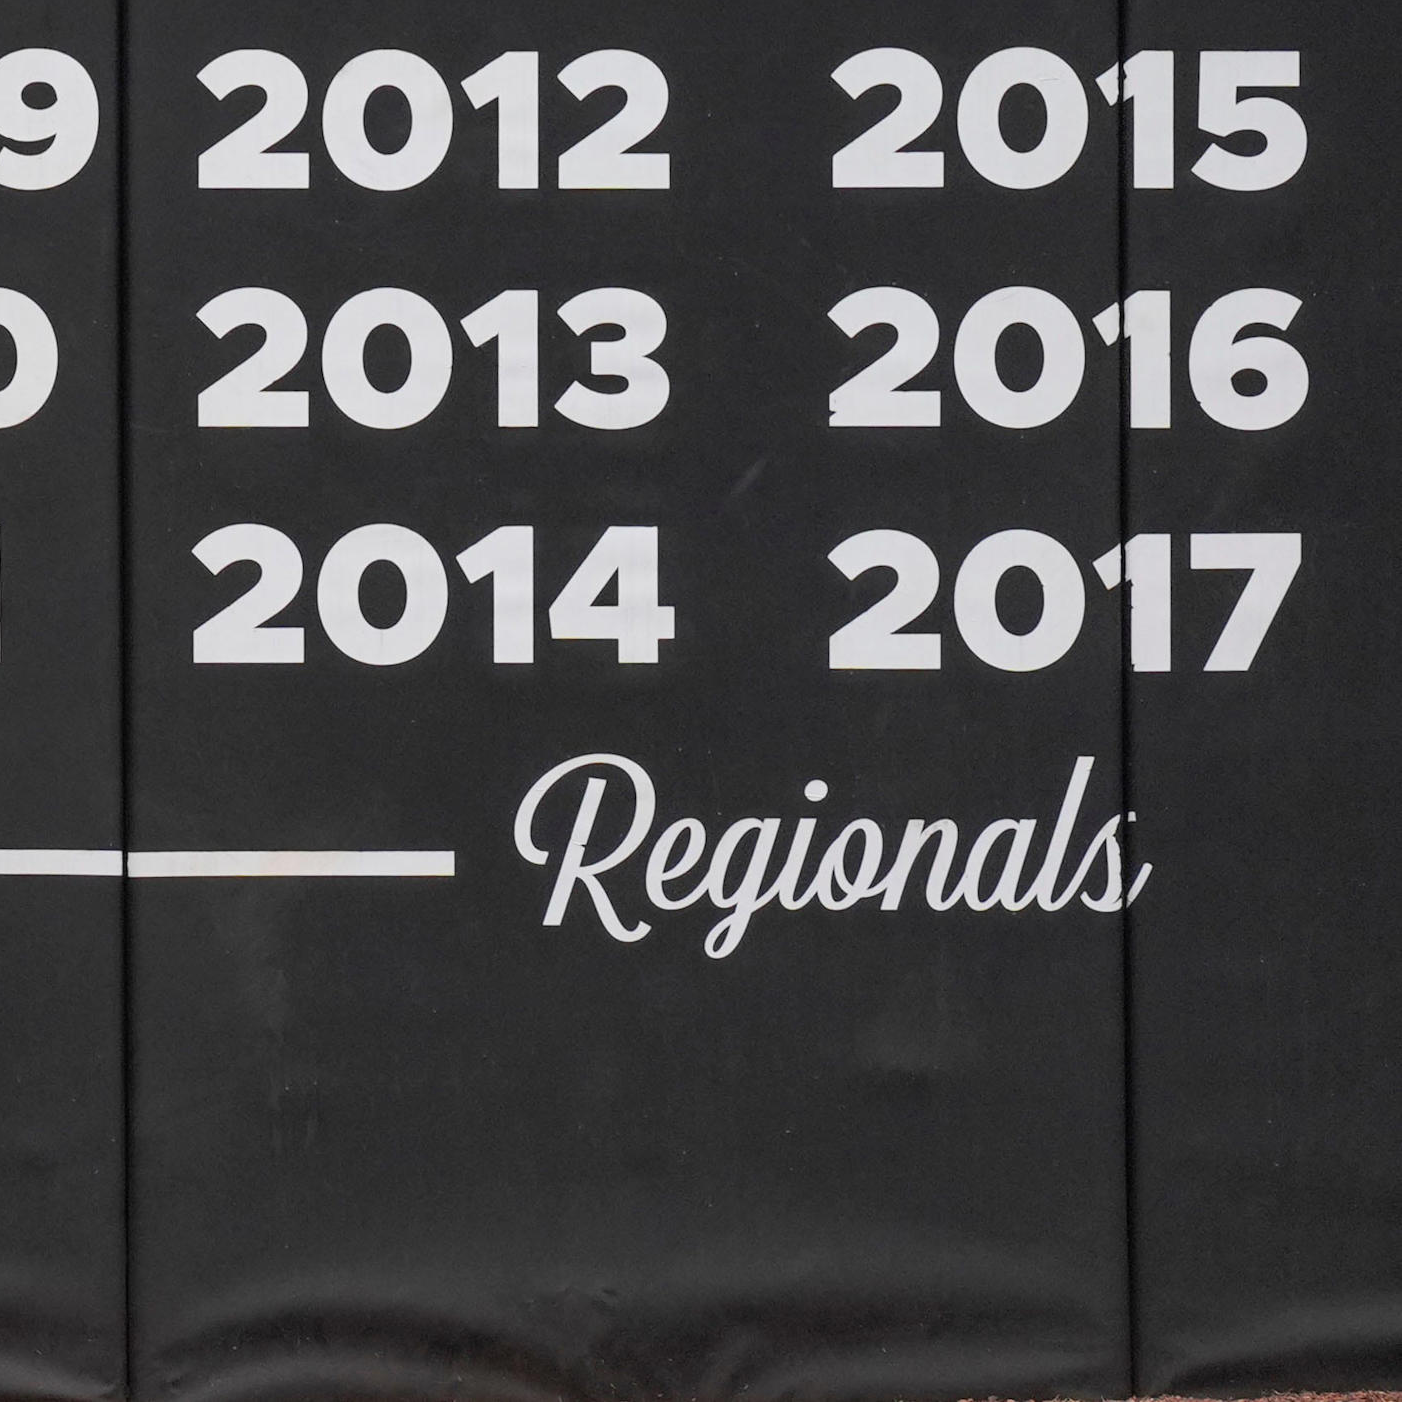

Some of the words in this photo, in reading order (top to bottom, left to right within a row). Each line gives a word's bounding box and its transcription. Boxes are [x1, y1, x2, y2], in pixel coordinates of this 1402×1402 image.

[196, 48, 671, 191] 2012
[830, 46, 1308, 192] 2015
[195, 287, 671, 430] 2013
[827, 286, 1310, 431] 2016
[191, 523, 676, 667] 2014
[827, 529, 1303, 673] 2017
[513, 752, 1153, 960] Regionals
